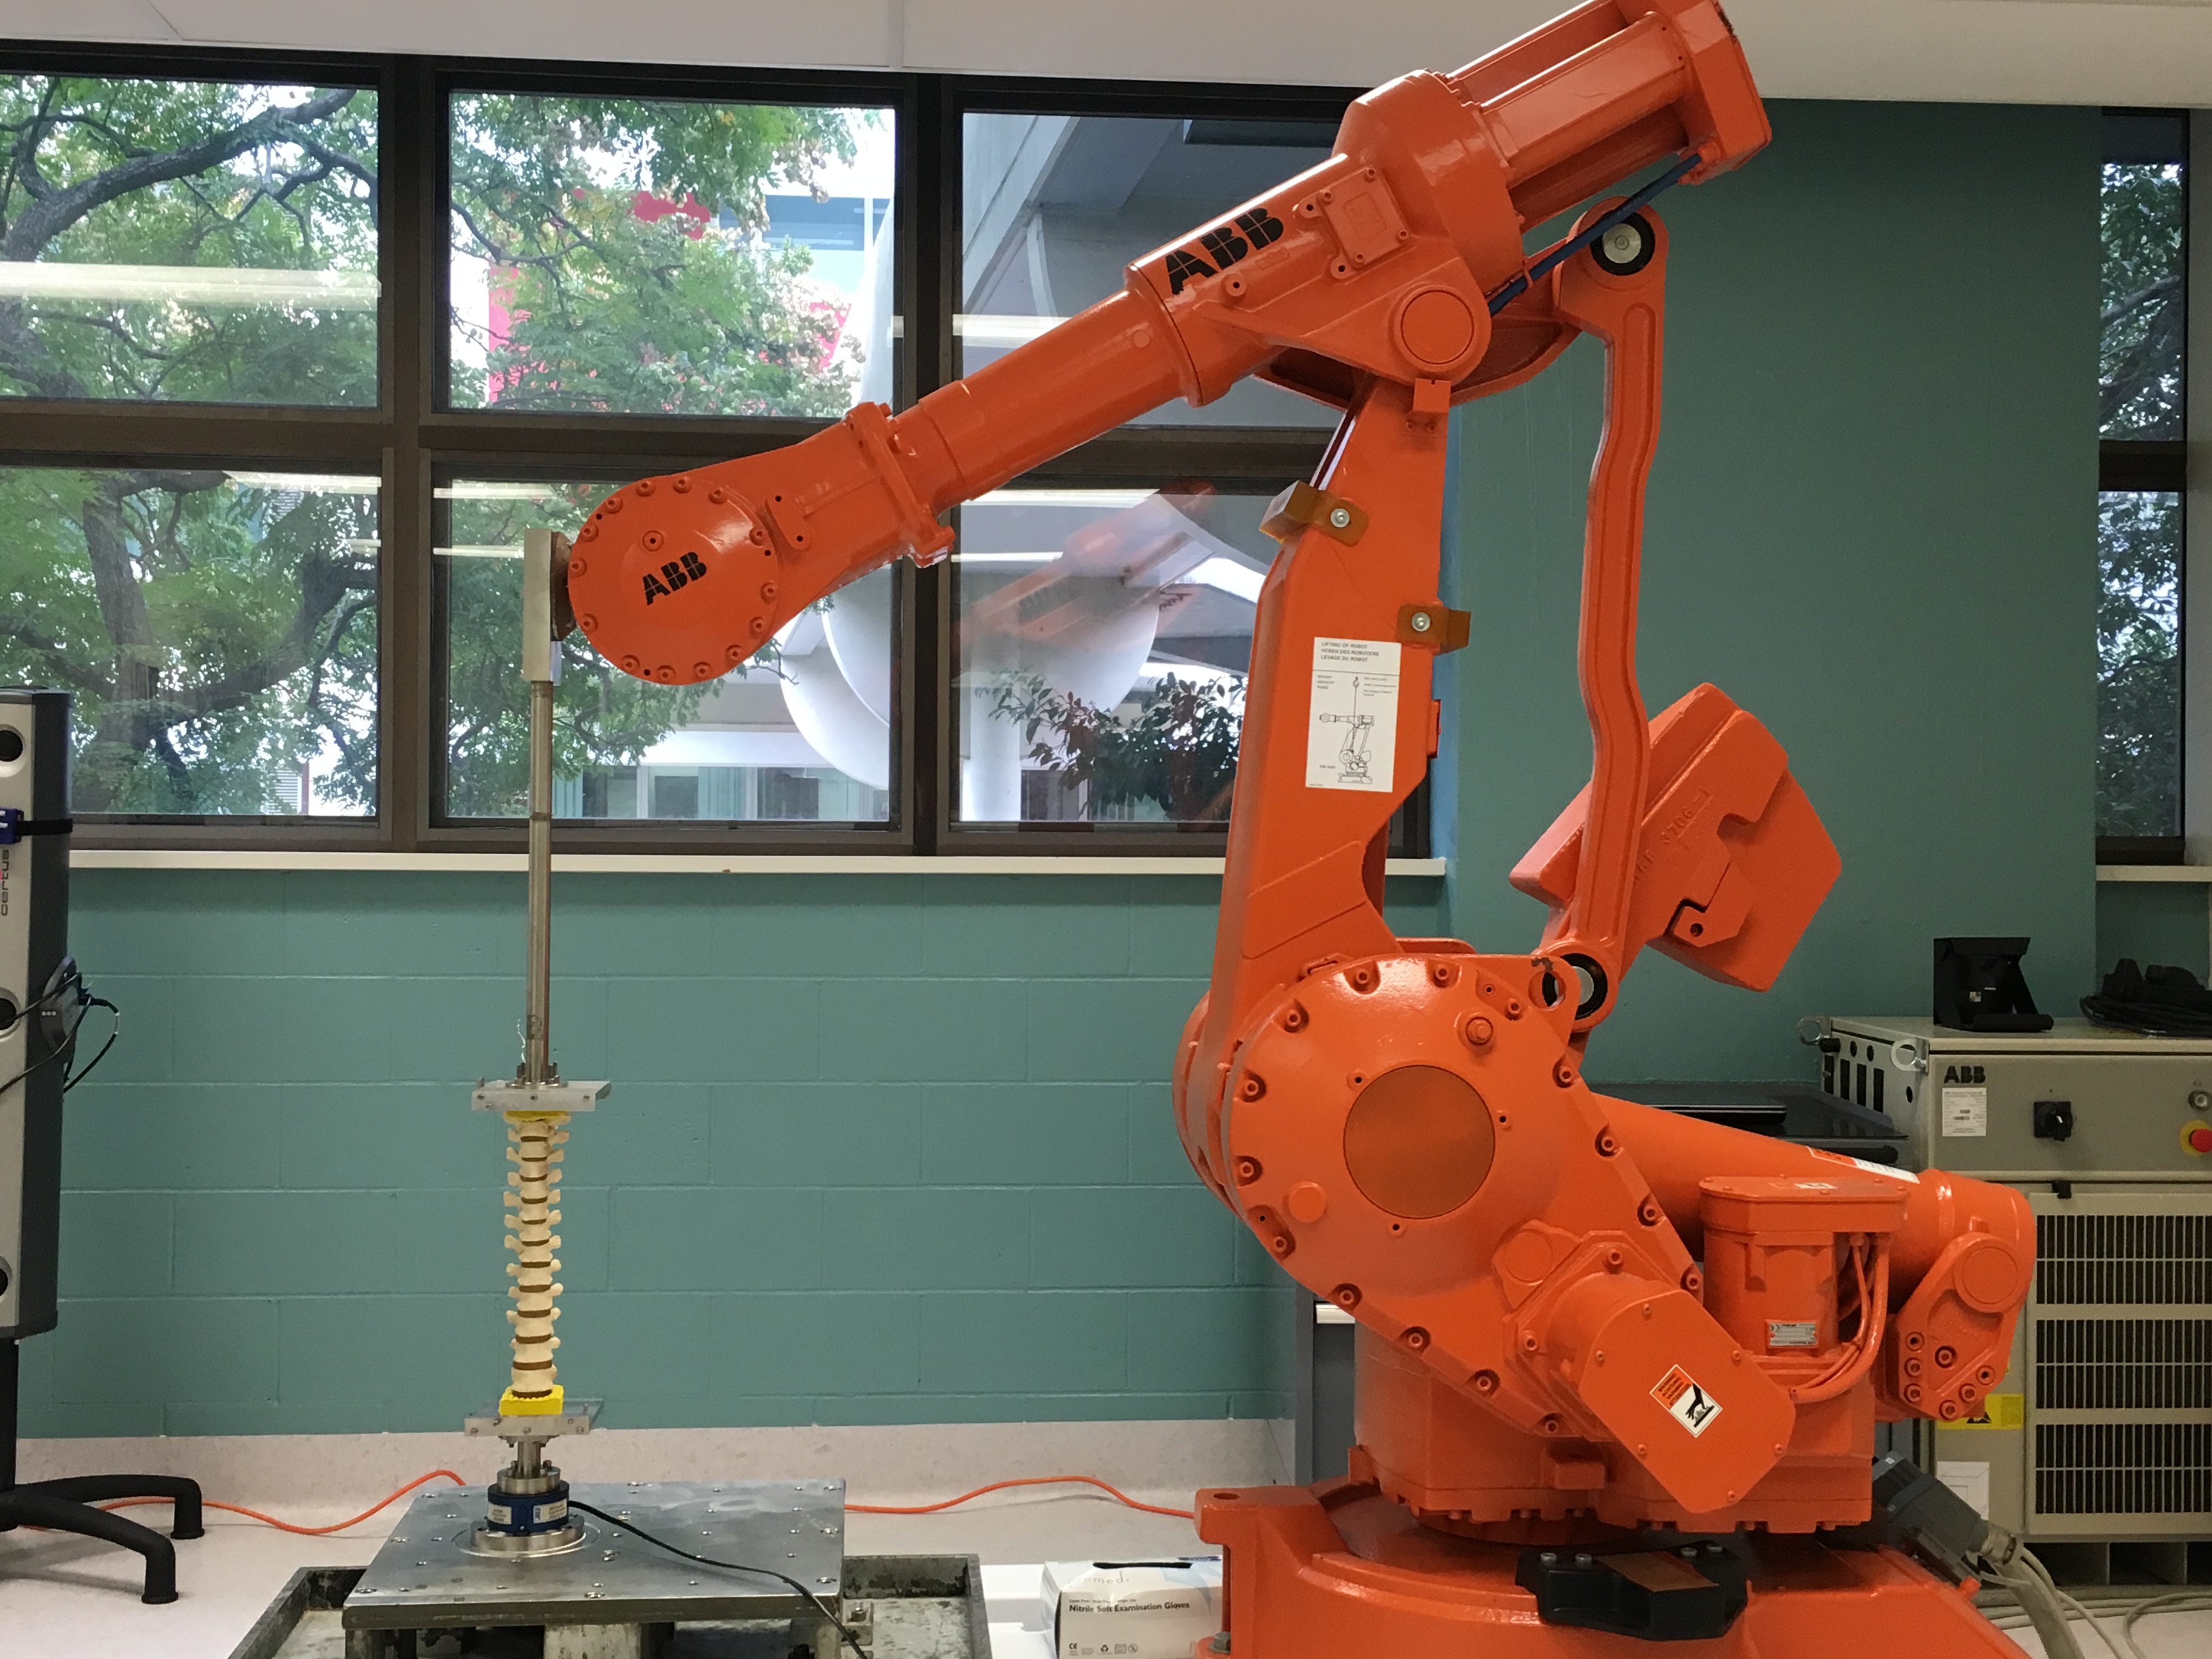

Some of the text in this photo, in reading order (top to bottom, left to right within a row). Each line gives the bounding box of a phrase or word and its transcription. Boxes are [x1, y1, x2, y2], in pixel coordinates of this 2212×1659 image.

[1165, 207, 1284, 295] ABB
[642, 552, 707, 606] ABB
[1944, 1065, 1986, 1084] ABB
[1114, 1602, 1162, 1612] Examination
